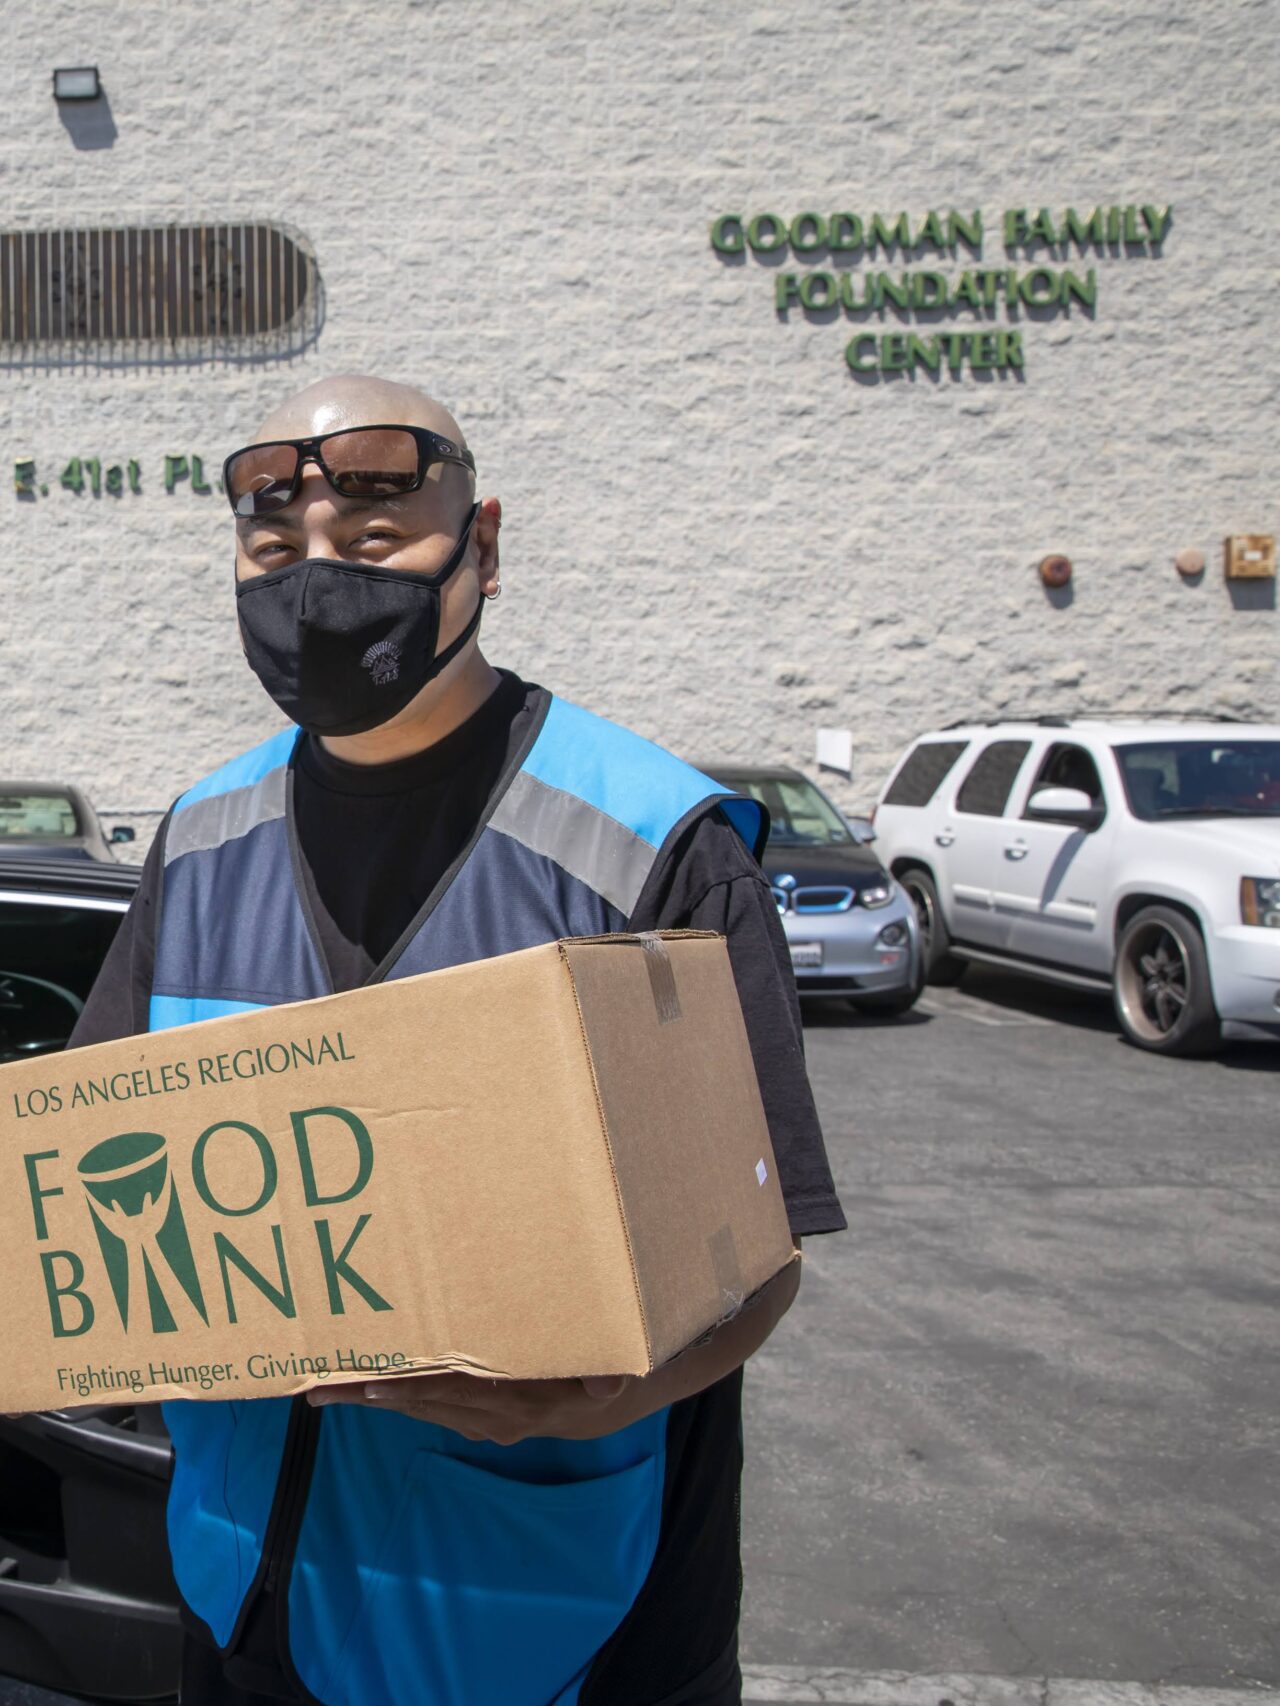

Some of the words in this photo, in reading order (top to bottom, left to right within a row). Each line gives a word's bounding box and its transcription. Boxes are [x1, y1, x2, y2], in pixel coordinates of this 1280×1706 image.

[709, 208, 984, 254] GOODMAN
[1003, 203, 1173, 248] FAMILY
[774, 268, 1098, 313] FOUNDATION
[844, 330, 1025, 373] CENTER
[15, 457, 48, 496] E.
[60, 456, 141, 497] 41st
[13, 1086, 63, 1118] LOS
[71, 1061, 191, 1109] ANGELES
[197, 1032, 356, 1086] REGIONAL
[23, 1106, 375, 1240] FOOD
[39, 1213, 395, 1339] BANK
[56, 1364, 144, 1397] Fighting
[148, 1361, 240, 1391] Hunger.
[246, 1353, 329, 1379] Giving
[335, 1348, 415, 1374] Hope.
